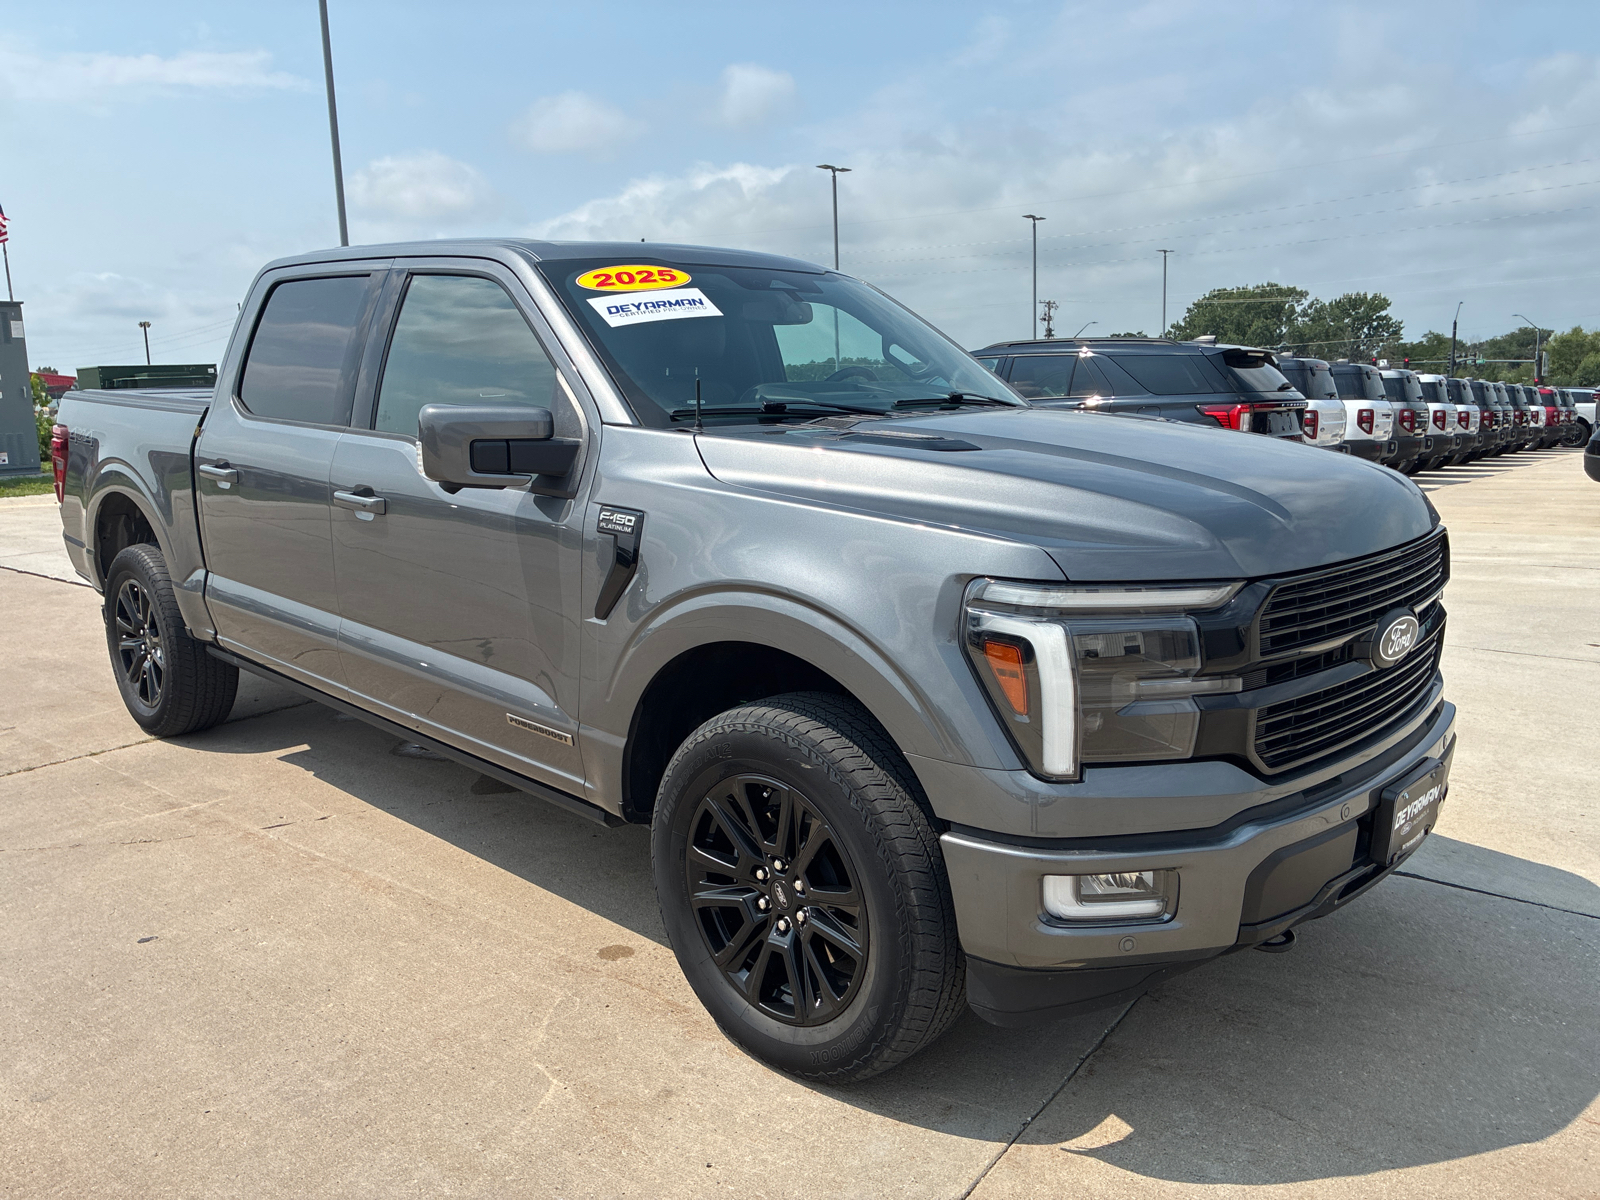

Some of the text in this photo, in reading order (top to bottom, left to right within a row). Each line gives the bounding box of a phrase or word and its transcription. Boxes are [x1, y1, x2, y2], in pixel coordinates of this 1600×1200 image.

[592, 269, 677, 288] 2025
[607, 298, 704, 315] DEYARMAN
[619, 305, 708, 318] CERTIFIED PRE-OWNED
[600, 511, 635, 526] F-150
[600, 522, 632, 533] PLATINUM
[1388, 622, 1413, 655] Ford
[509, 716, 569, 743] POWERBOOST
[1394, 784, 1441, 830] DEYARMAN
